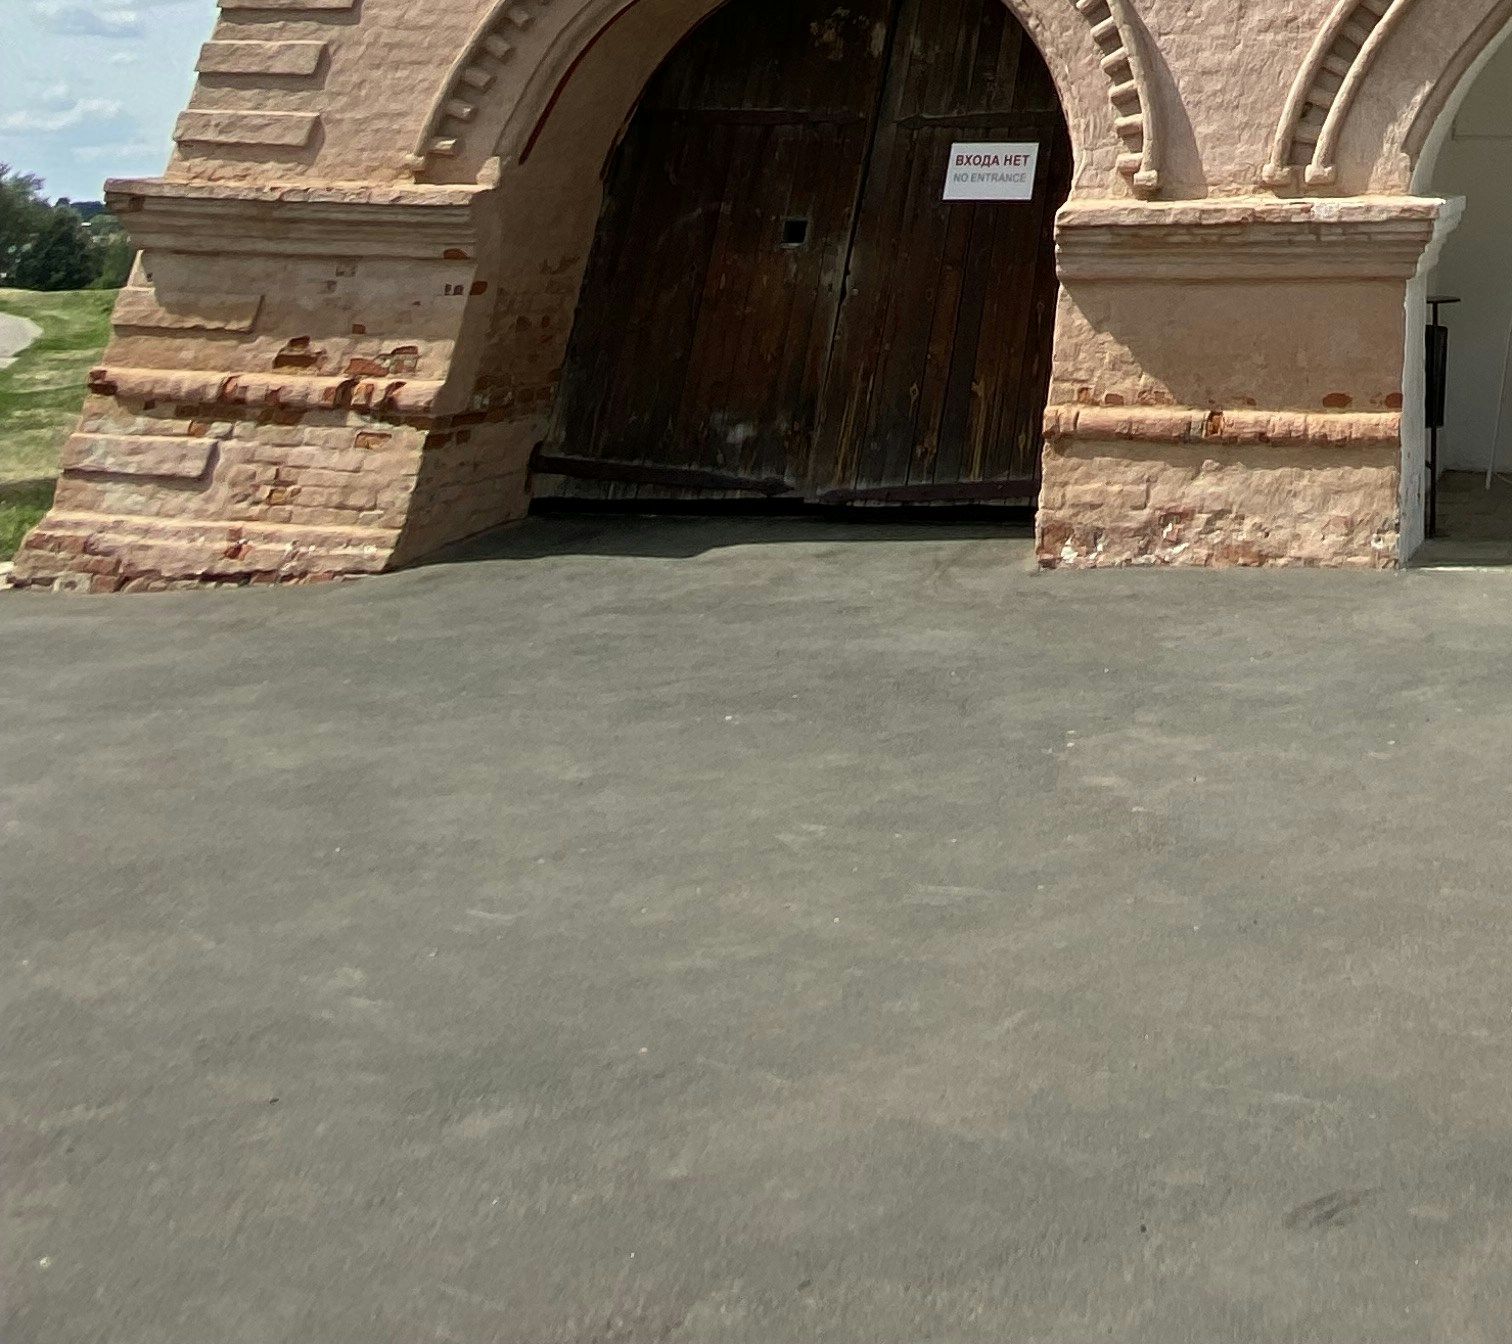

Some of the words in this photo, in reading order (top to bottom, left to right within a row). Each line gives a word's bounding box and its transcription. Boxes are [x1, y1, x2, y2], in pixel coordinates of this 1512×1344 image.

[955, 154, 1000, 168] ВХОДА
[1003, 154, 1030, 167] НЕТ
[953, 172, 970, 183] NO
[970, 172, 1027, 183] ENTRANCE
